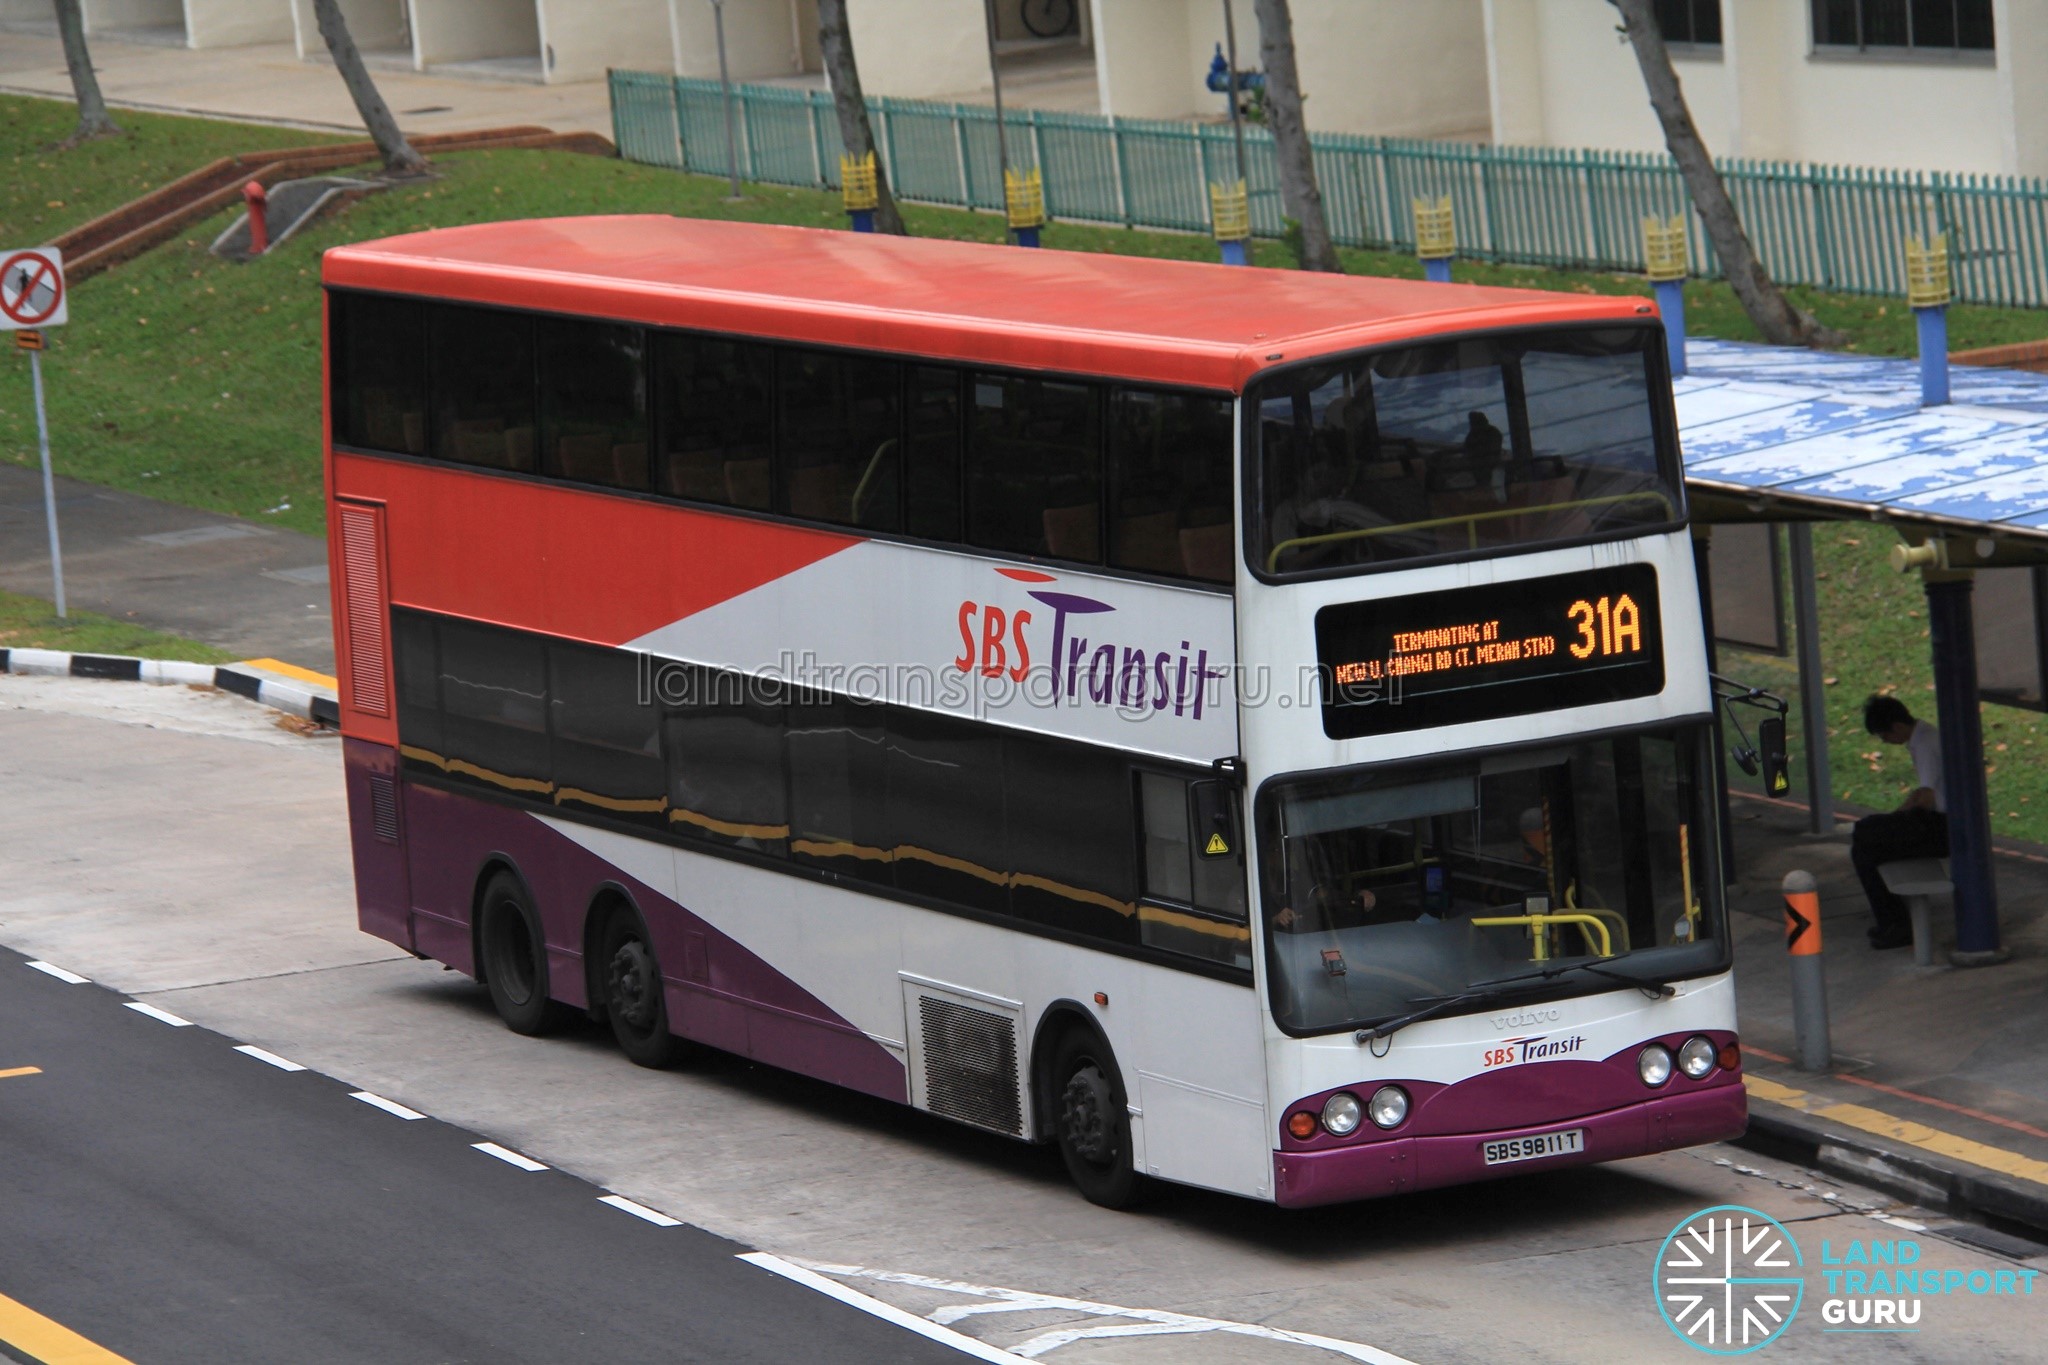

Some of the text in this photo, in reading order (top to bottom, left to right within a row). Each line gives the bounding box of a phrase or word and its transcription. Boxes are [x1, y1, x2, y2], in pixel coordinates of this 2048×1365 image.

[1393, 620, 1499, 653] TERMINATING AT
[1567, 593, 1642, 660] 31A
[955, 590, 1226, 721] SBS Transit
[1336, 635, 1556, 684] NEW U. CHANGI RD (T. MERAH STN)
[1490, 1008, 1562, 1031] VOLVO
[1483, 1035, 1588, 1068] SBS Transit
[1486, 1132, 1578, 1163] SBS9811T
